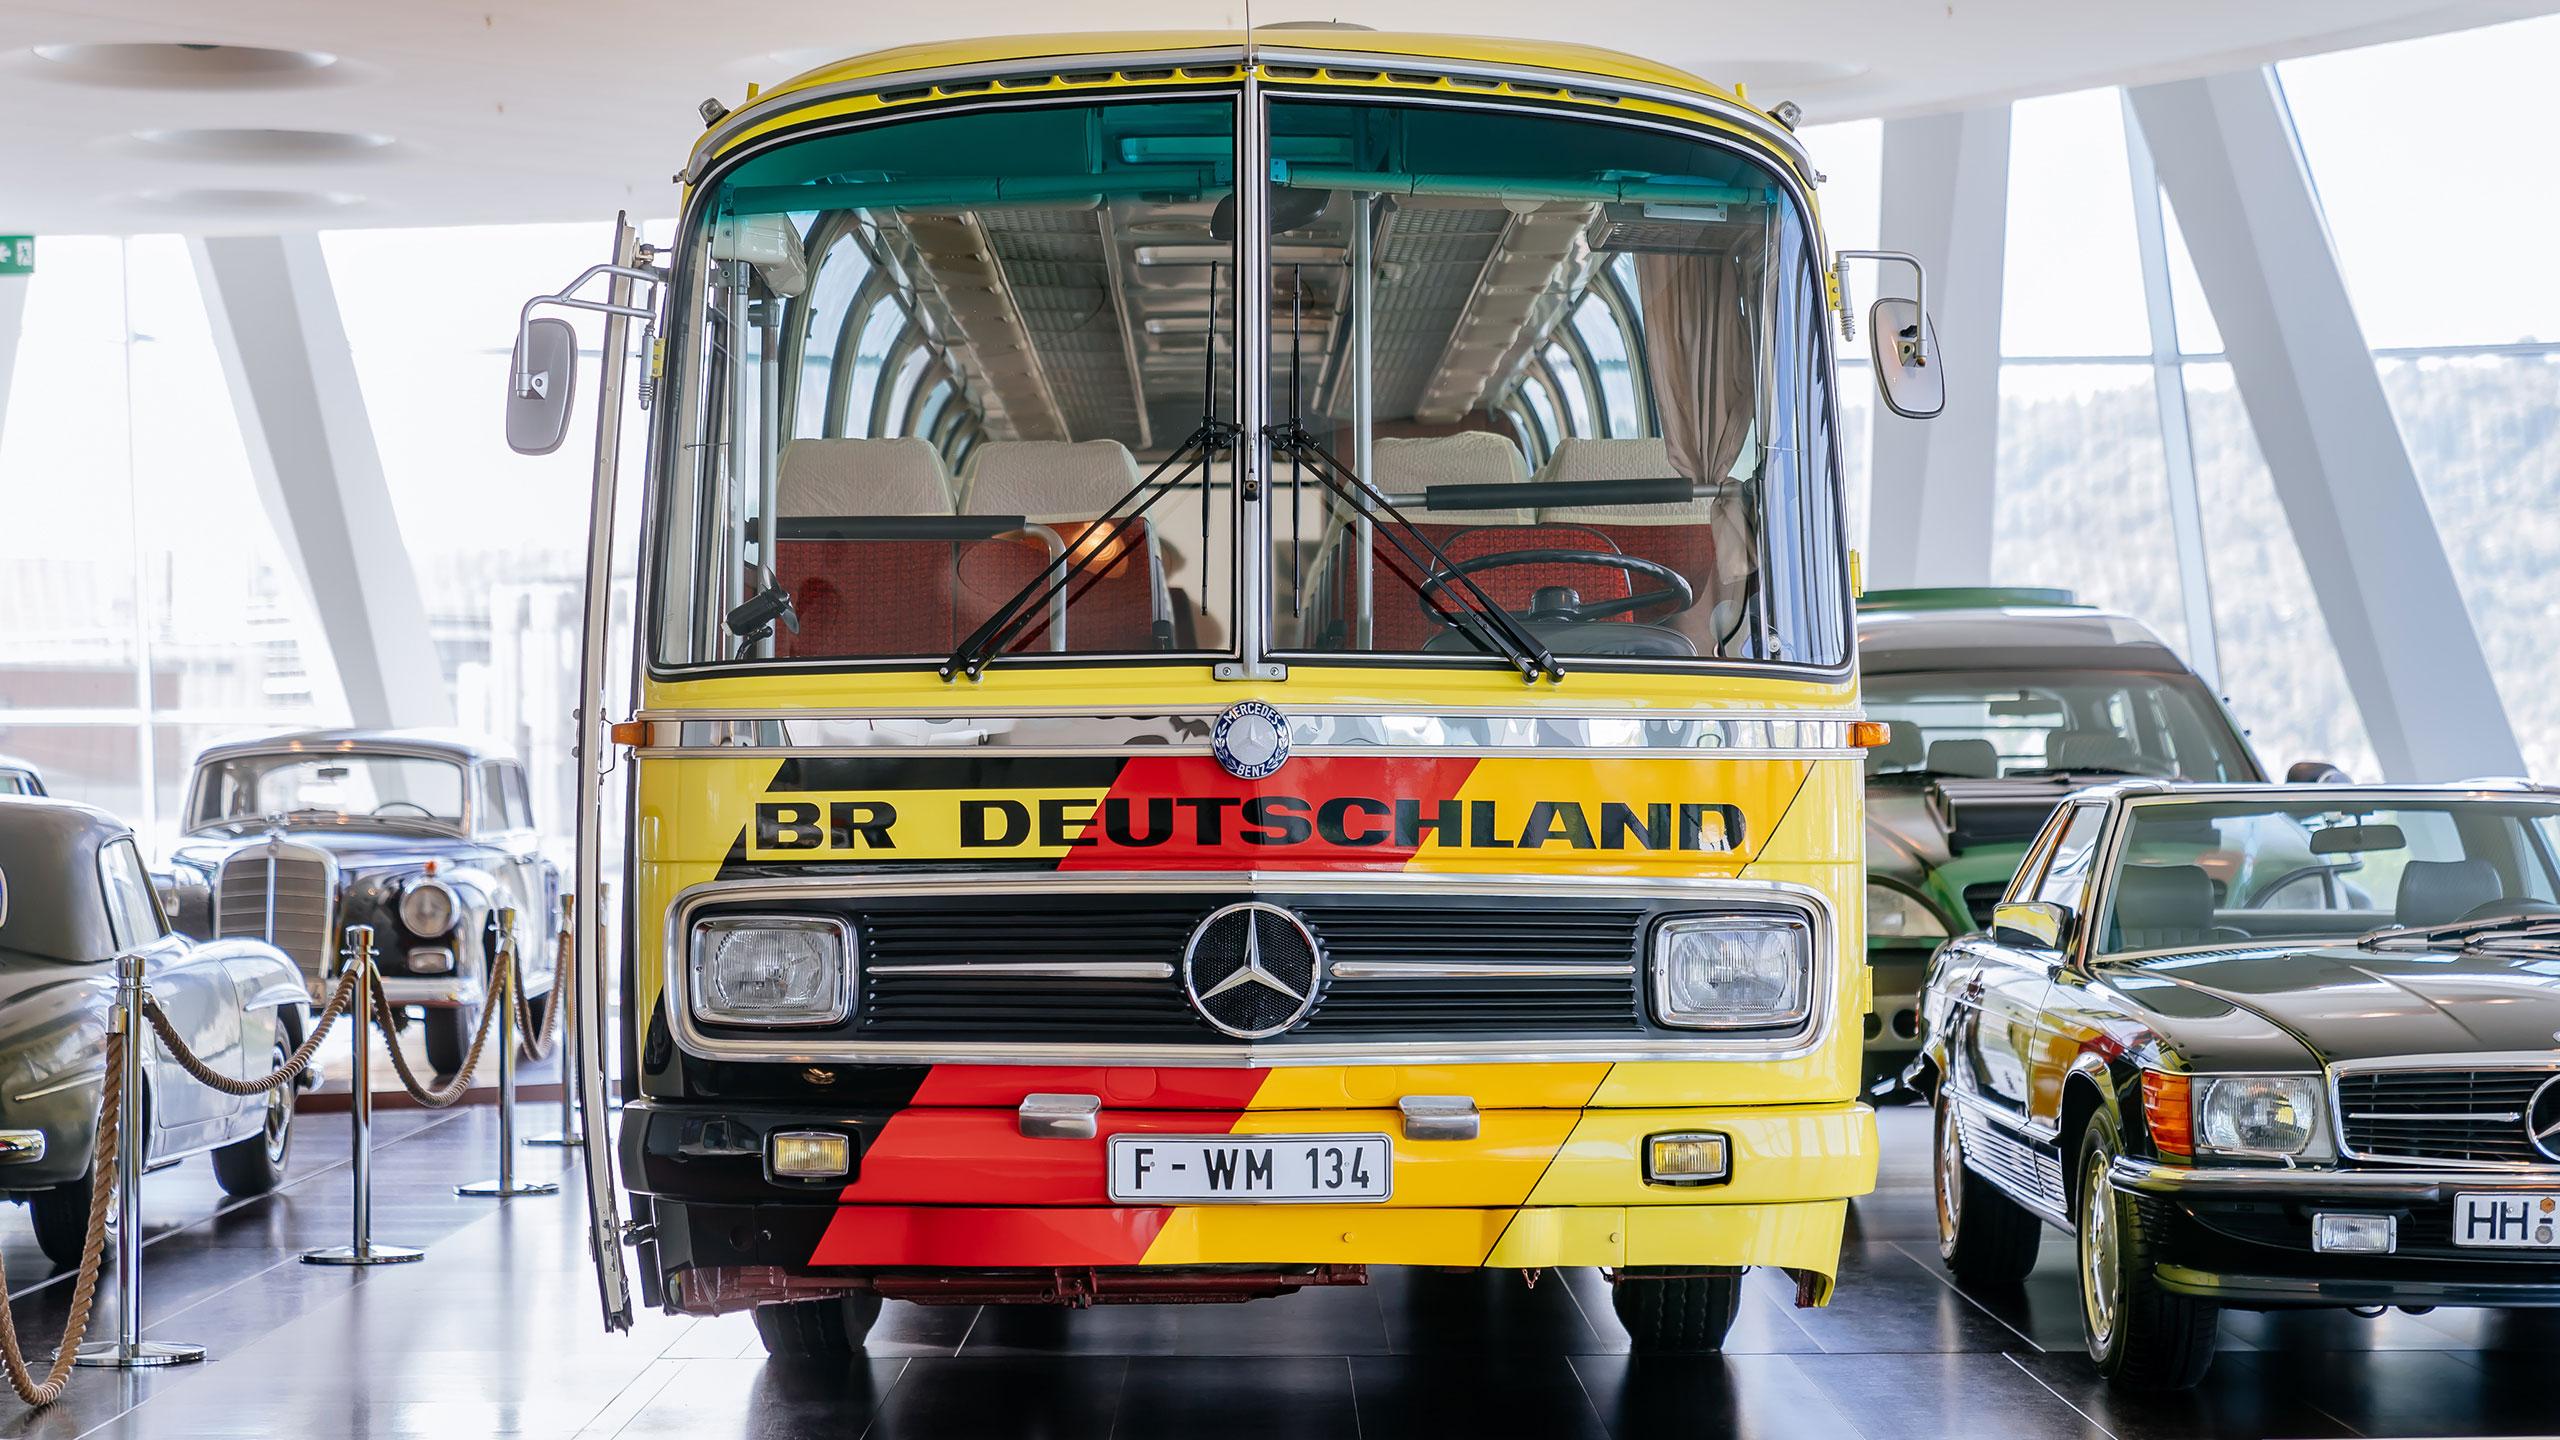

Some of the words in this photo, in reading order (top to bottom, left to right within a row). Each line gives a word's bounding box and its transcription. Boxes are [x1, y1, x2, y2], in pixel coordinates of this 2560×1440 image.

[1223, 703, 1281, 725] MERCEDES
[1236, 763, 1268, 777] BENZ
[755, 800, 897, 850] BR
[959, 795, 1748, 852] DEUTSCHLAND
[1305, 1147, 1370, 1189] 134
